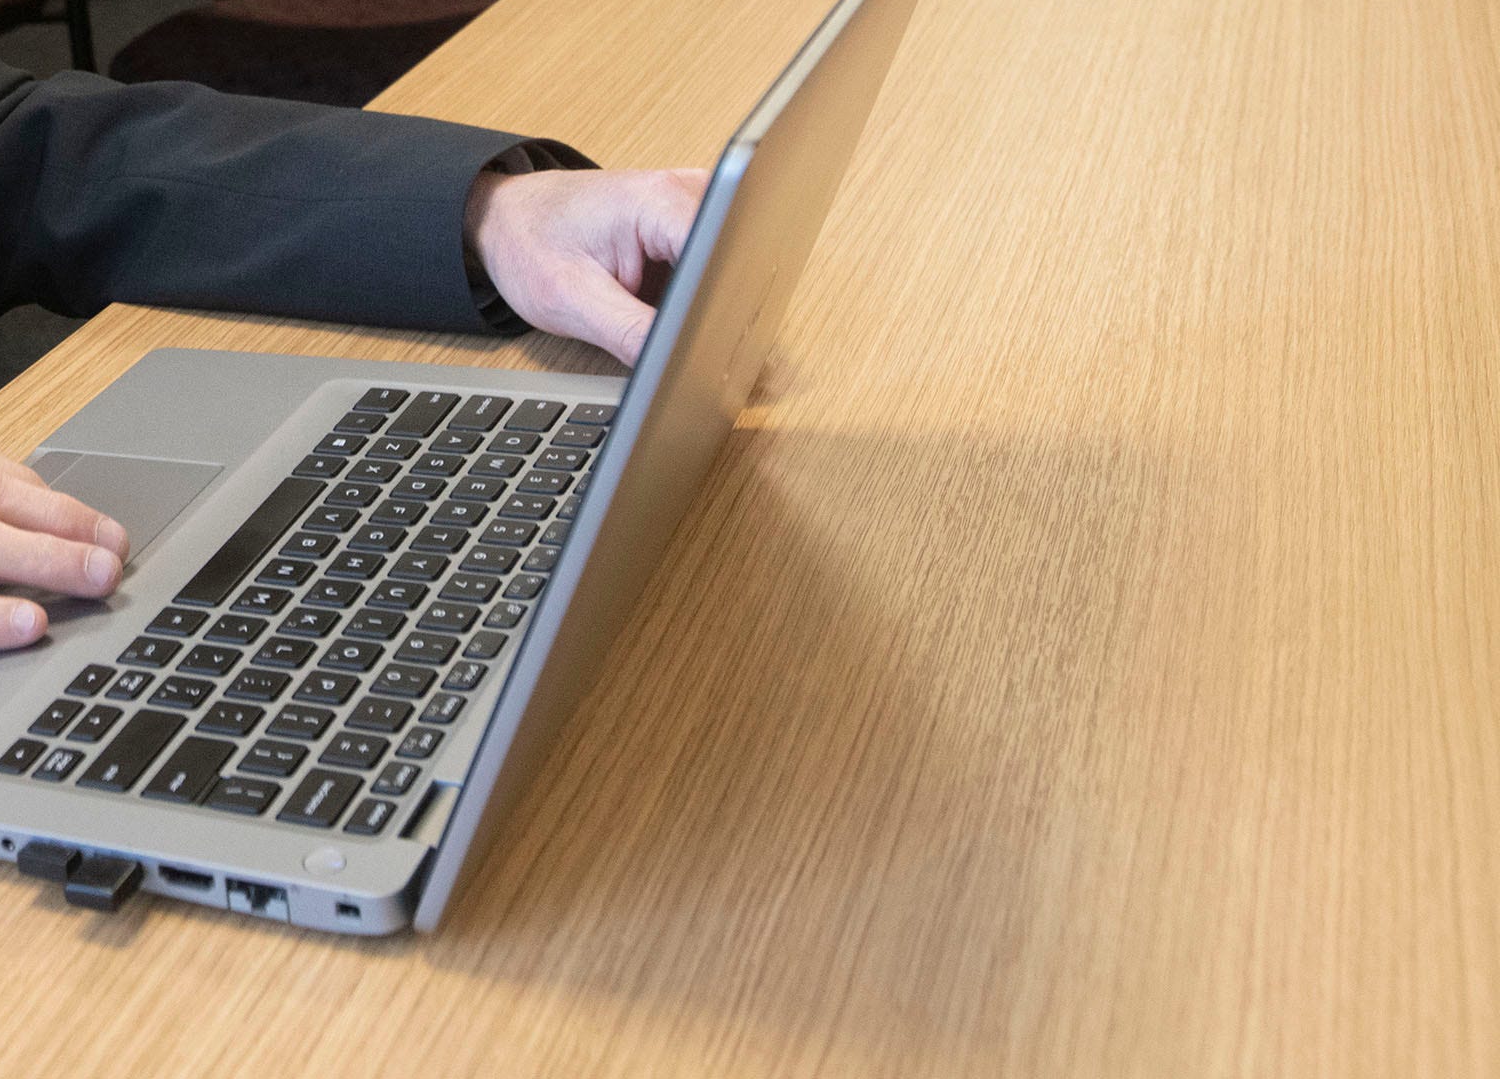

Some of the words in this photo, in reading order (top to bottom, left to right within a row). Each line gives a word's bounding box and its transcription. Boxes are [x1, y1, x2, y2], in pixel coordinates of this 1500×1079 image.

[448, 436, 462, 444] A
[505, 437, 521, 445] Q
[385, 442, 401, 451] Z
[430, 459, 444, 467] S
[489, 459, 505, 469] W
[365, 465, 381, 474] X
[411, 481, 426, 490] D
[471, 482, 486, 491] E
[345, 488, 360, 497] C
[512, 499, 524, 507] 4
[393, 506, 406, 514] F
[451, 506, 467, 515] R
[325, 513, 340, 522] V
[493, 525, 507, 533] 5
[369, 531, 384, 540] G
[433, 533, 448, 542] T
[301, 538, 317, 547] B
[473, 552, 487, 560] 6
[347, 558, 364, 568] H
[412, 560, 428, 569] Y
[454, 580, 468, 589] 7
[389, 588, 406, 597] U
[253, 593, 271, 604] M
[300, 614, 318, 625] K
[275, 644, 293, 654] L
[343, 647, 360, 658] O
[321, 679, 336, 690] P
